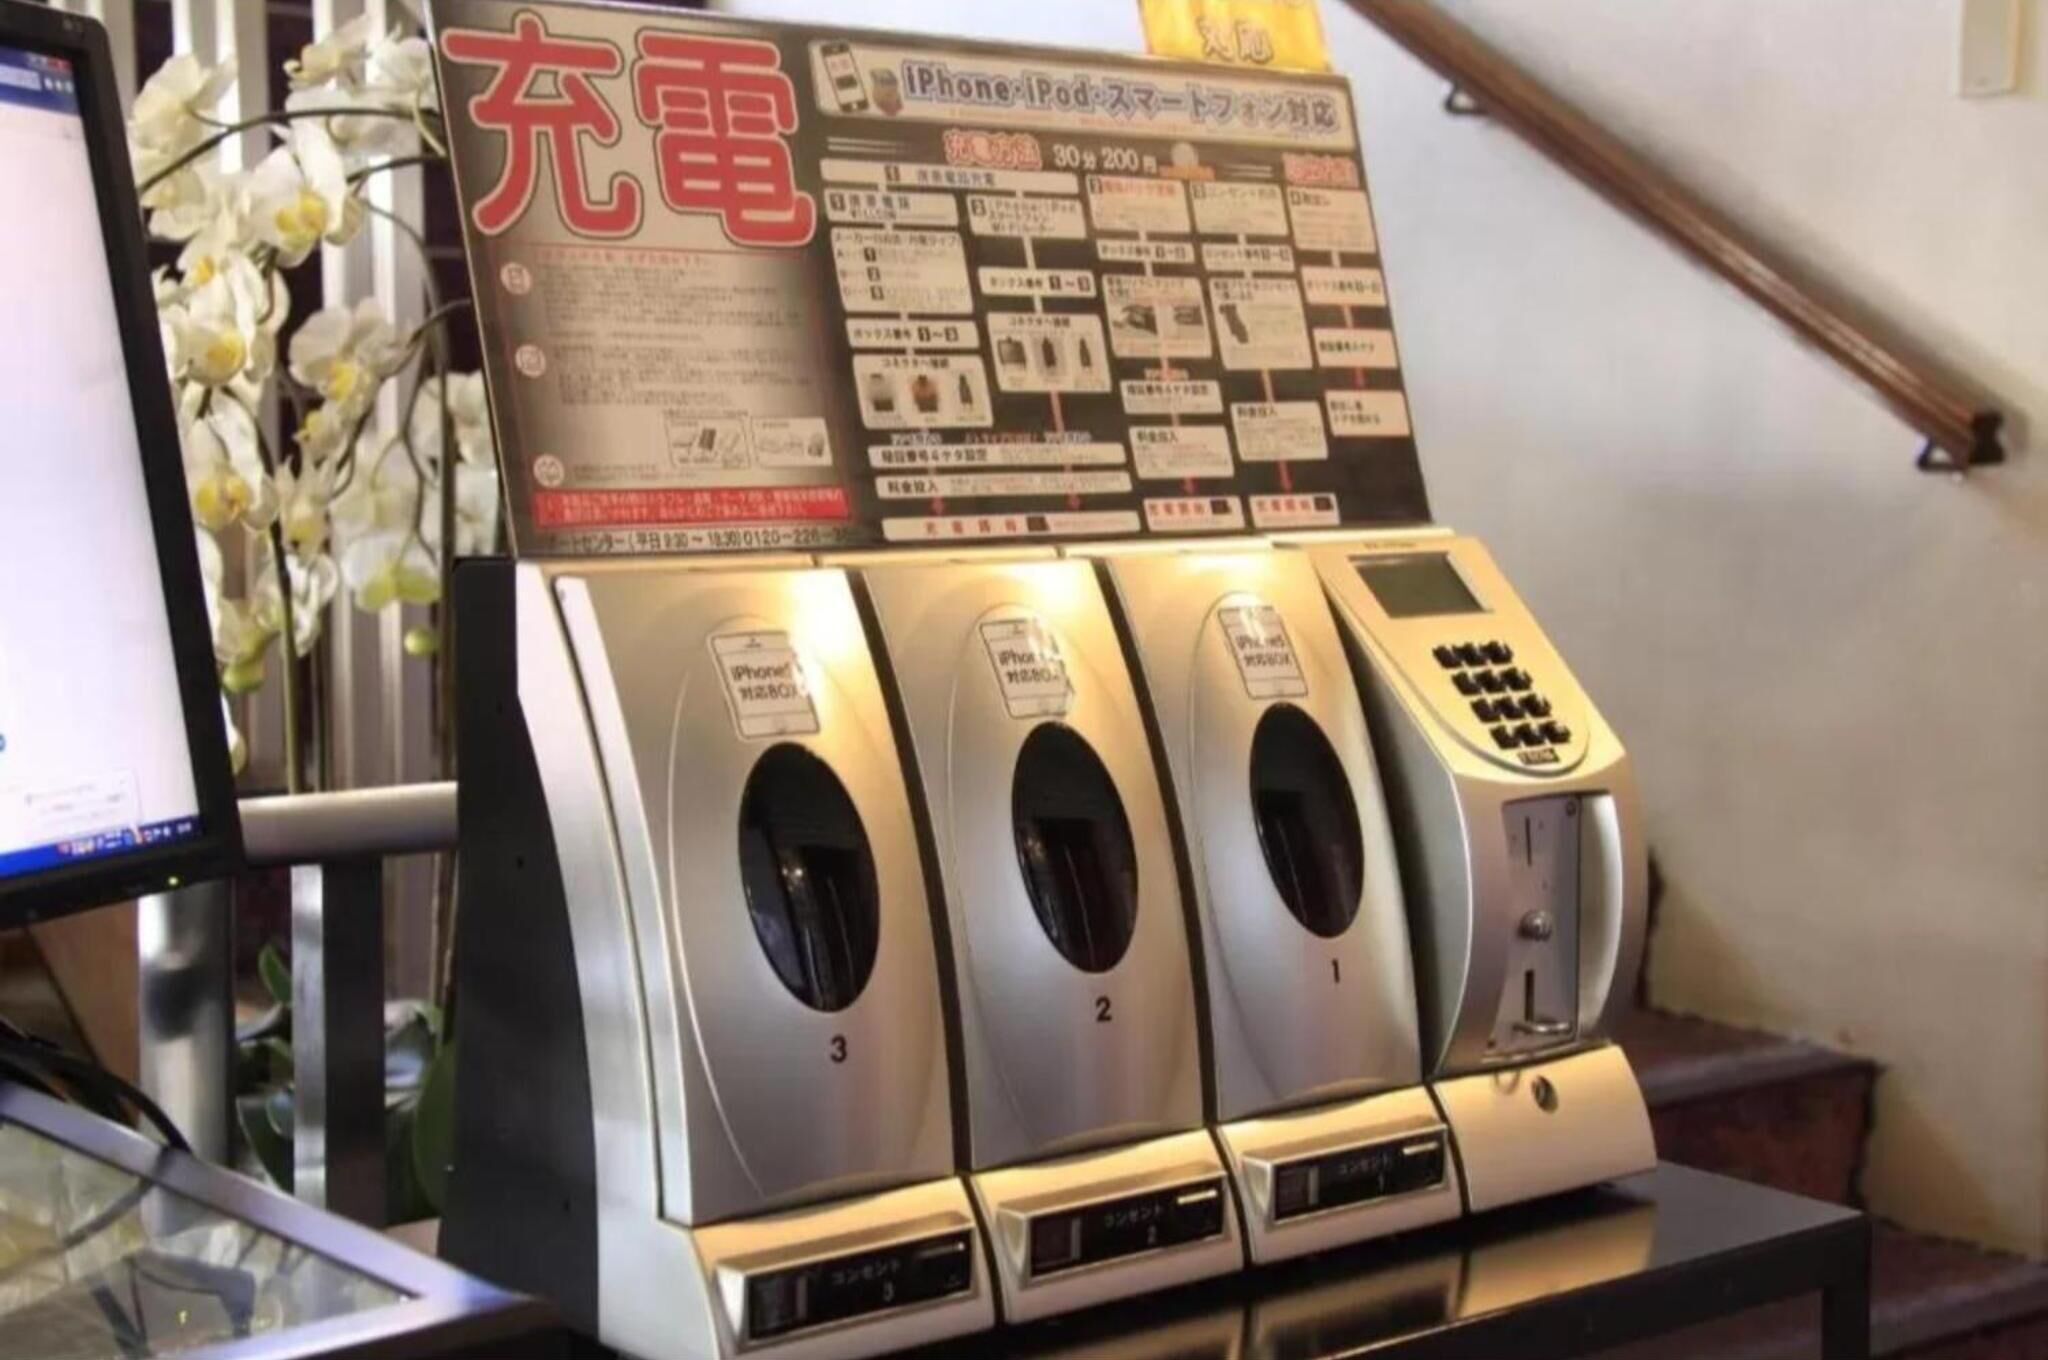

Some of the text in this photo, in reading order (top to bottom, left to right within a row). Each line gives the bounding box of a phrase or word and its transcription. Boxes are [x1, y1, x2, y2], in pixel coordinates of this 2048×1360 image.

[440, 9, 816, 246] 充電
[1053, 144, 1158, 174] 30分 200円
[880, 447, 989, 464] 暗証番号4ケタ設定
[886, 479, 940, 495] 料金投入
[1330, 958, 1341, 984] 1
[1095, 996, 1113, 1023] 2
[829, 1035, 849, 1064] 3
